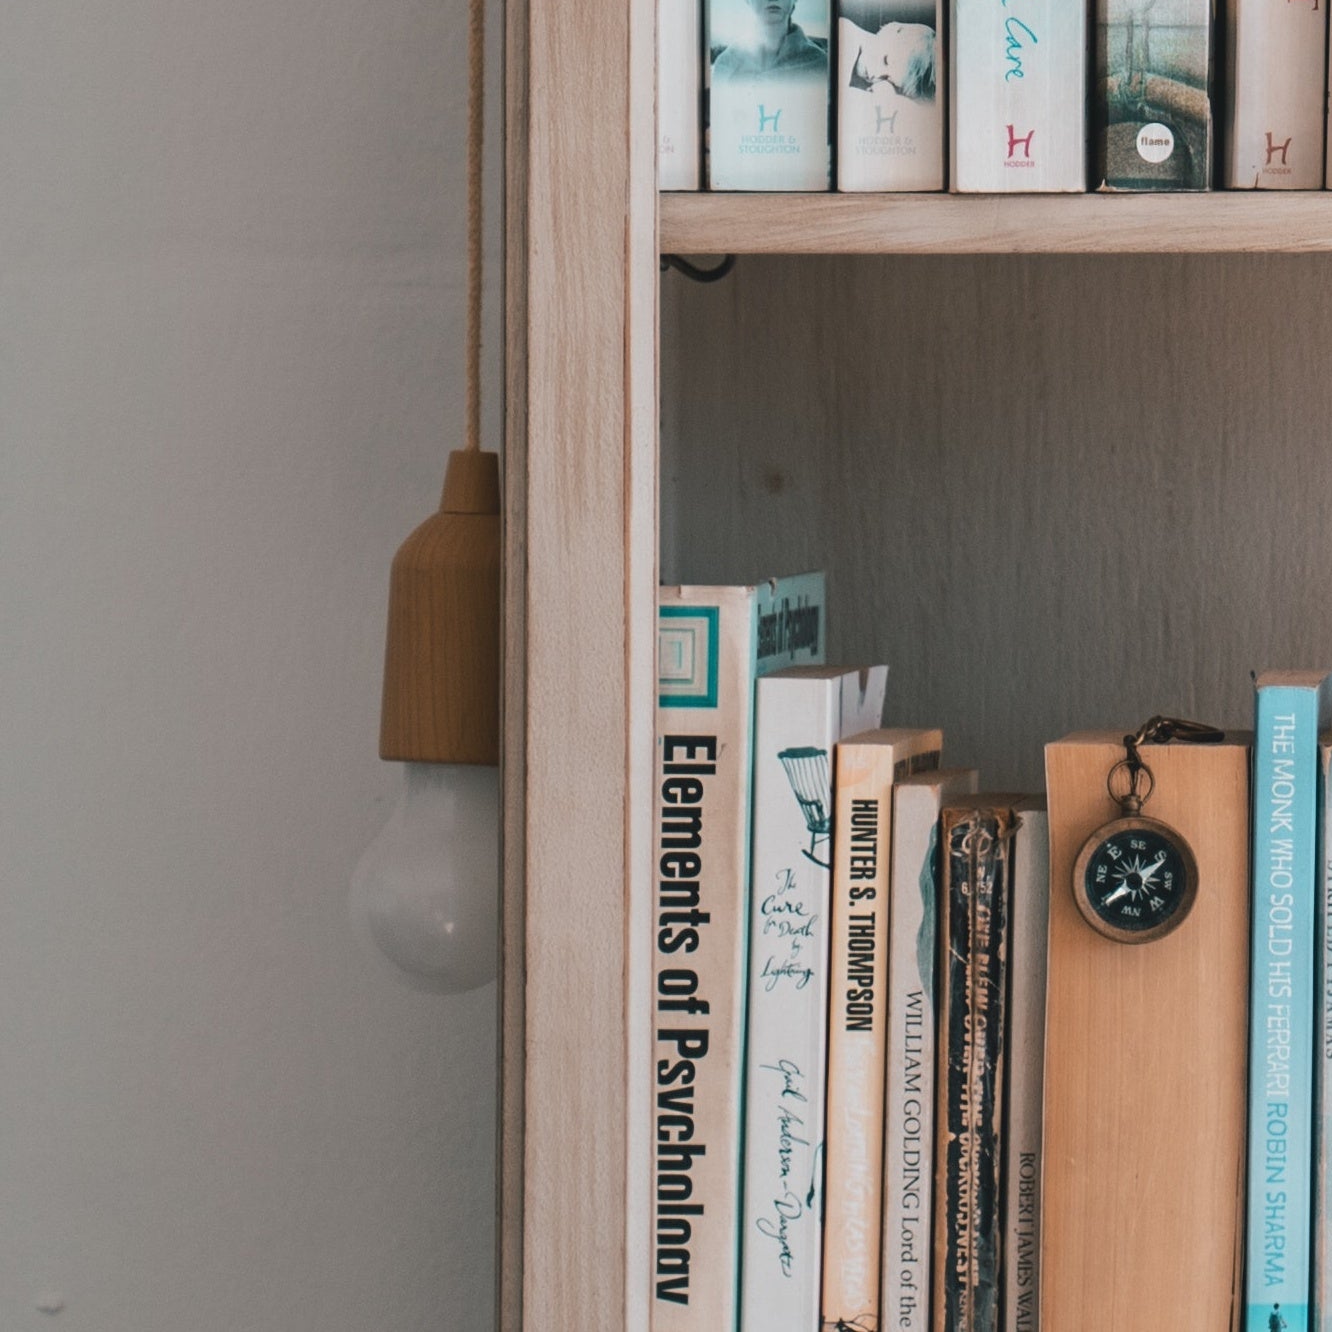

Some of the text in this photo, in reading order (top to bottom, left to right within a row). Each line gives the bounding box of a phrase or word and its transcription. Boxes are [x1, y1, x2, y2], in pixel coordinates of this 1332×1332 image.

[1003, 18, 1040, 82] Care
[659, 735, 718, 954] Elements
[845, 798, 878, 1033] HUNTER S. THOMPSON
[1266, 714, 1295, 1097] THE MONK WHO SOLD HIS FERRARI
[661, 970, 712, 1016] of
[899, 991, 922, 1327] WILLIAM GOLDING Lord of the
[1264, 1102, 1289, 1287] ROBIN SHARMA
